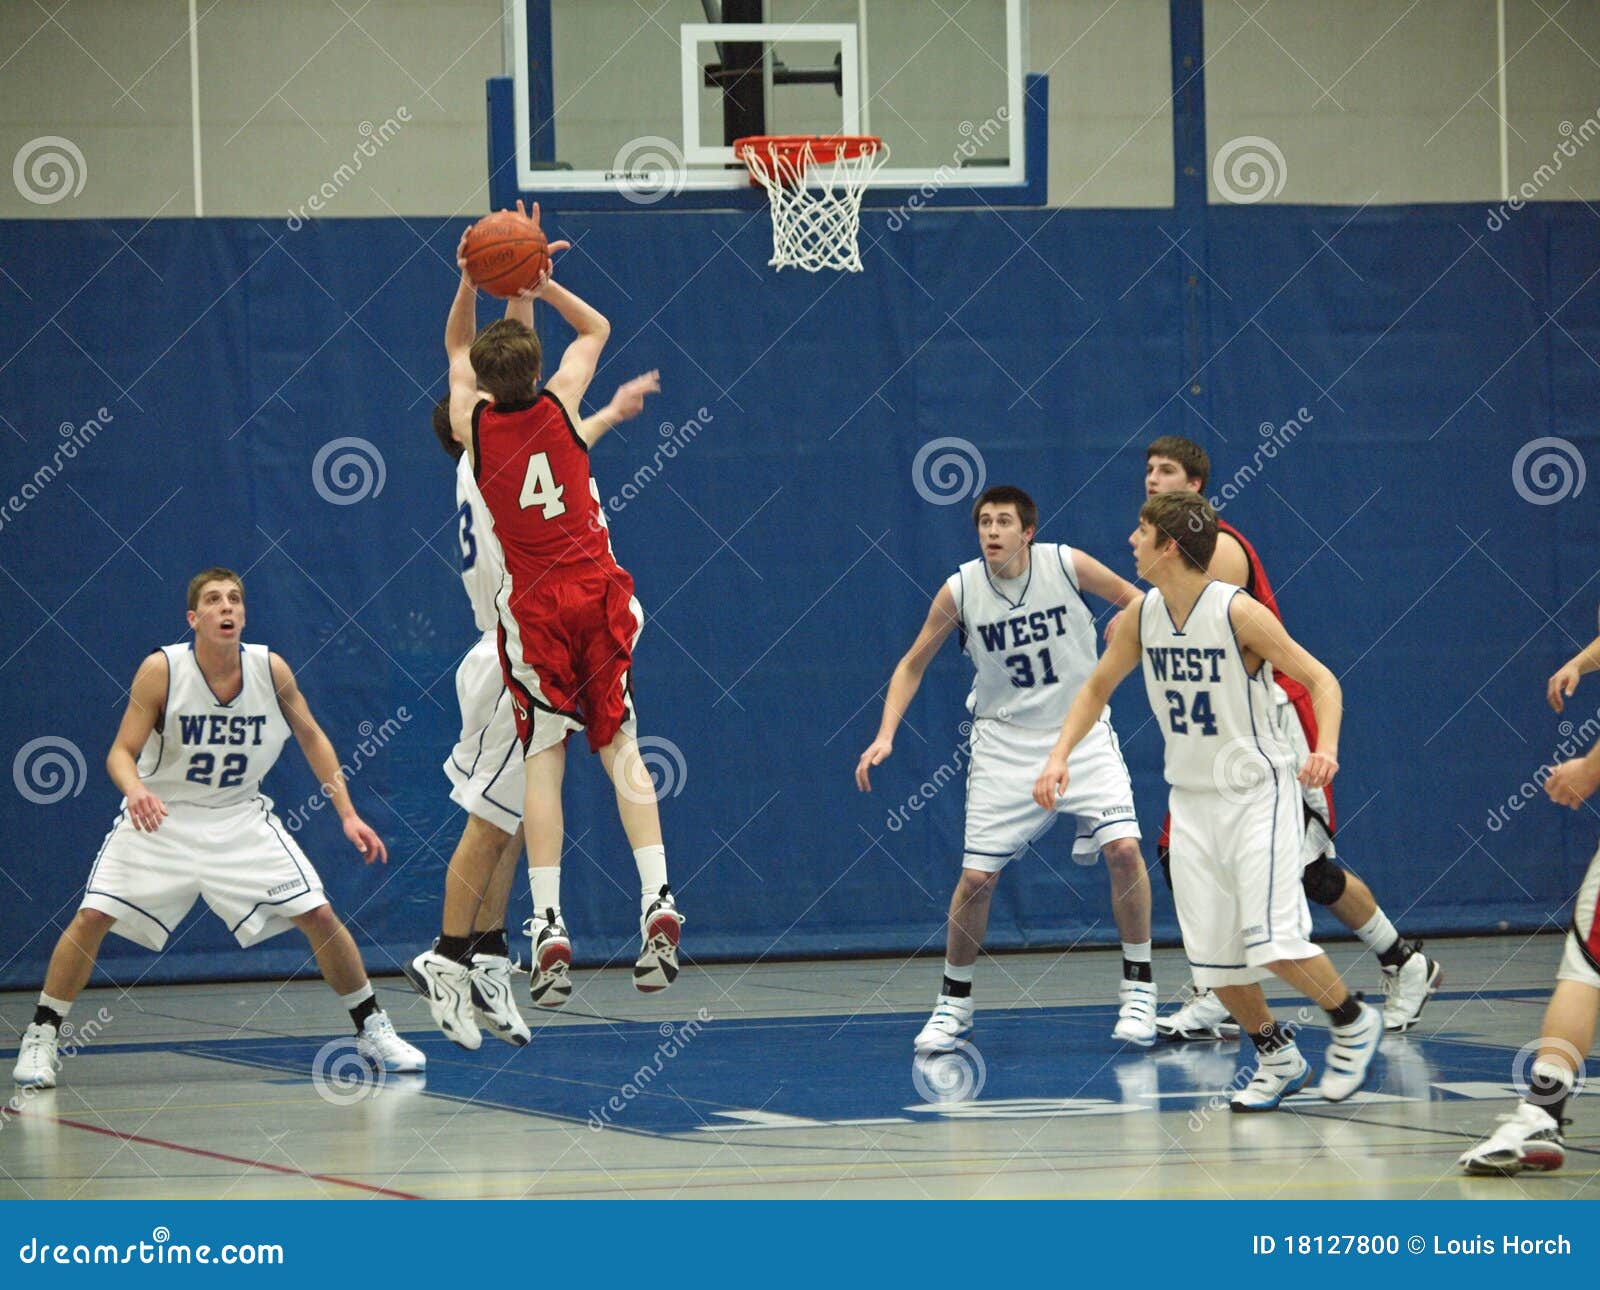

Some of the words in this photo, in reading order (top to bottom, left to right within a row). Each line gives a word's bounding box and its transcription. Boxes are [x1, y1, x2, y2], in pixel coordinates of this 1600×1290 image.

[518, 451, 566, 521] 4
[977, 605, 1067, 652] WEST
[1005, 647, 1059, 688] 31
[1146, 647, 1226, 682] WEST
[179, 715, 266, 745] WEST
[1165, 689, 1218, 736] 24
[186, 753, 247, 788] 22
